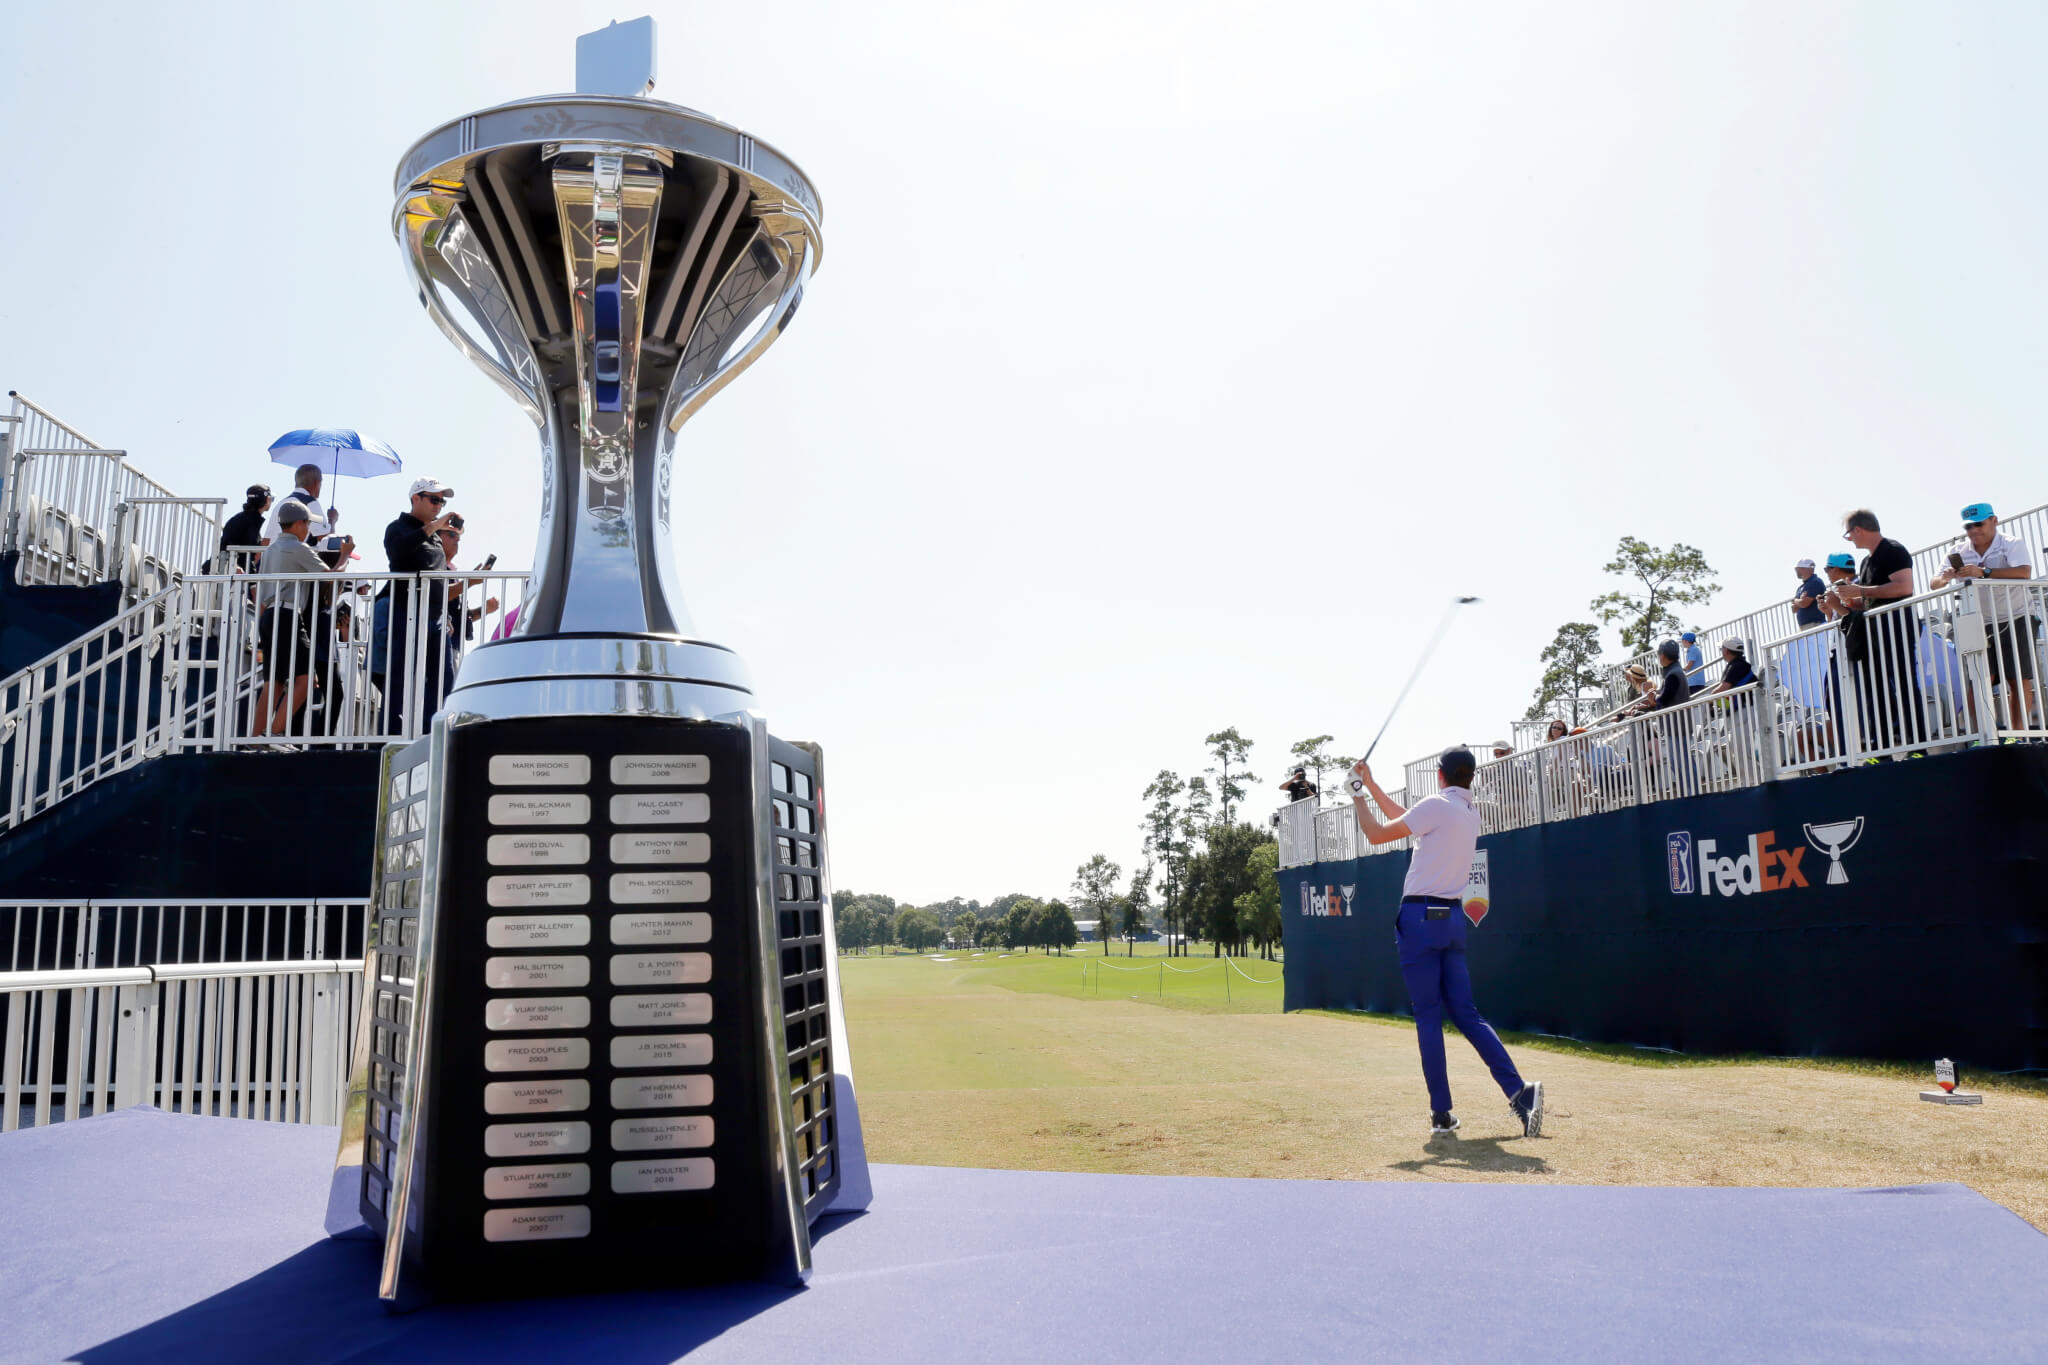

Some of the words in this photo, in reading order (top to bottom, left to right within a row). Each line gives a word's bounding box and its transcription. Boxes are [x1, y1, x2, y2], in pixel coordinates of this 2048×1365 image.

[1468, 871, 1486, 885] PEN
[1698, 830, 1809, 897] FedEx
[1310, 885, 1342, 917] FedEx
